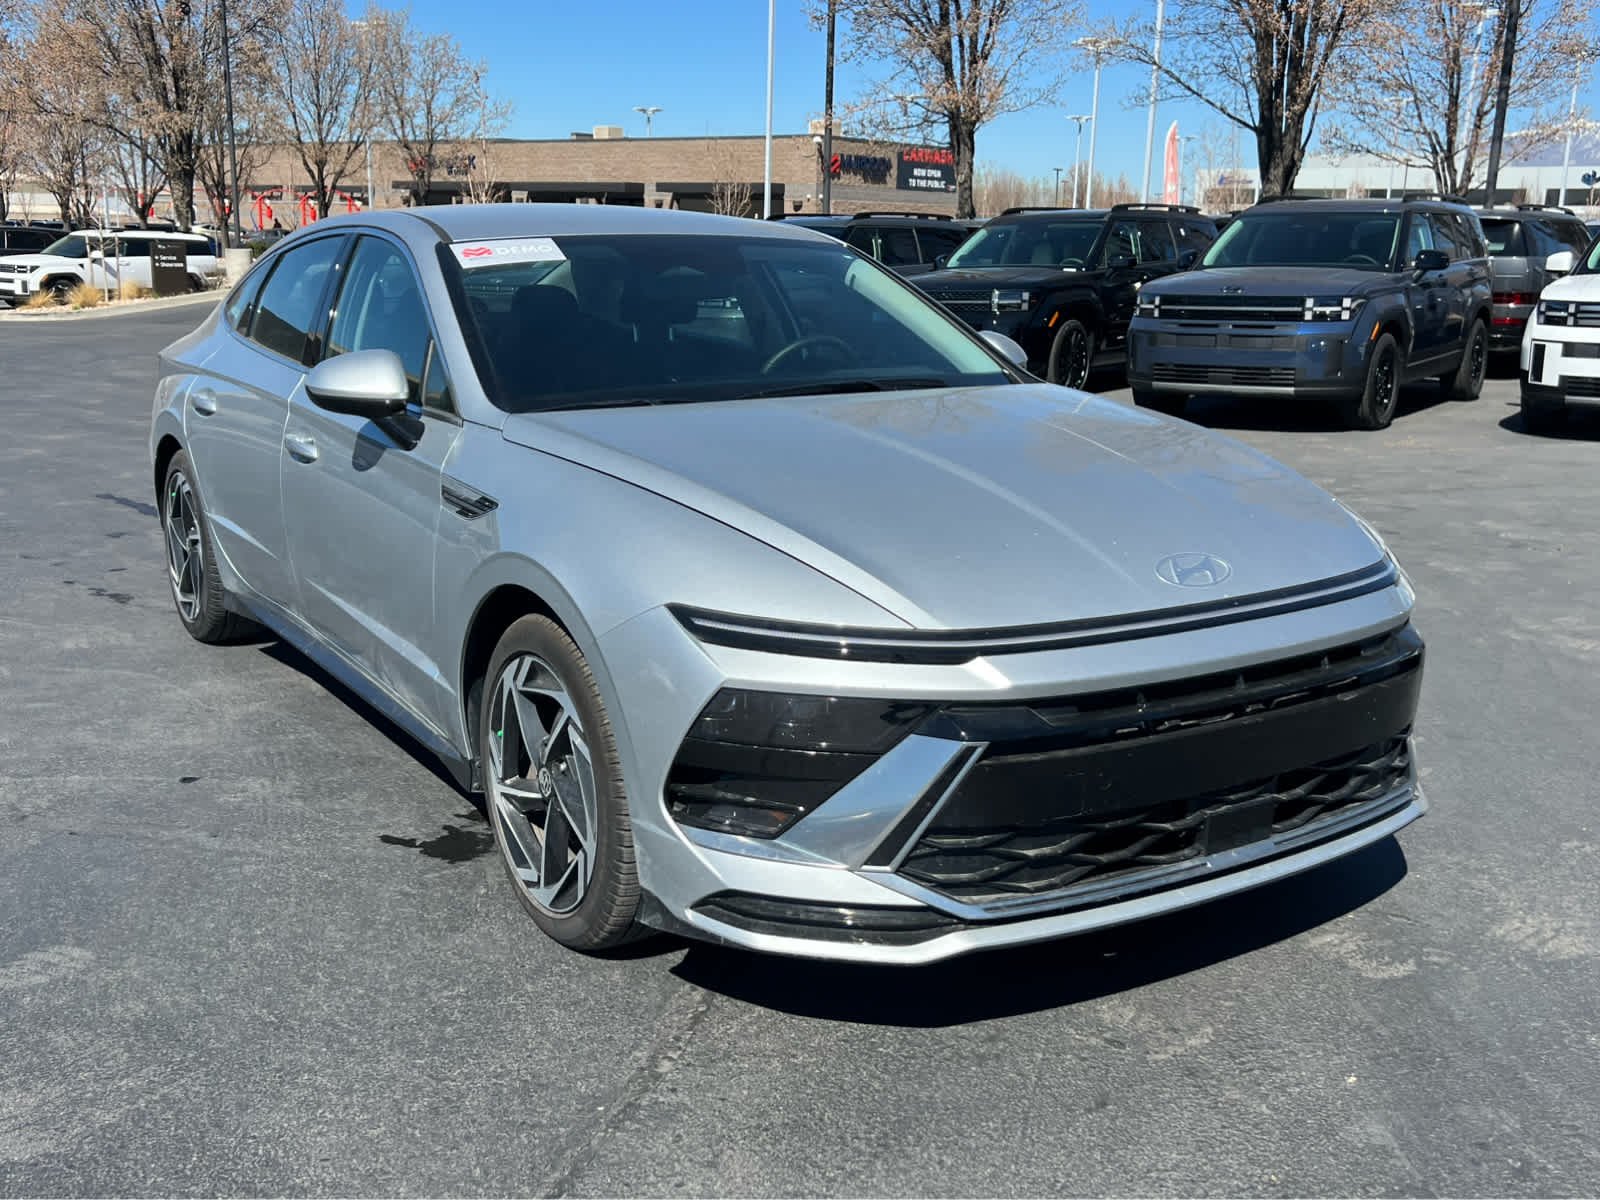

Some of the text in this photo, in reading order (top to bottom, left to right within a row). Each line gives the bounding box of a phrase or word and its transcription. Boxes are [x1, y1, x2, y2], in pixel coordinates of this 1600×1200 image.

[913, 167, 941, 178] NOW OPEN
[908, 178, 916, 187] TO
[927, 180, 946, 189] PUBLIC
[495, 244, 553, 257] DEMO
